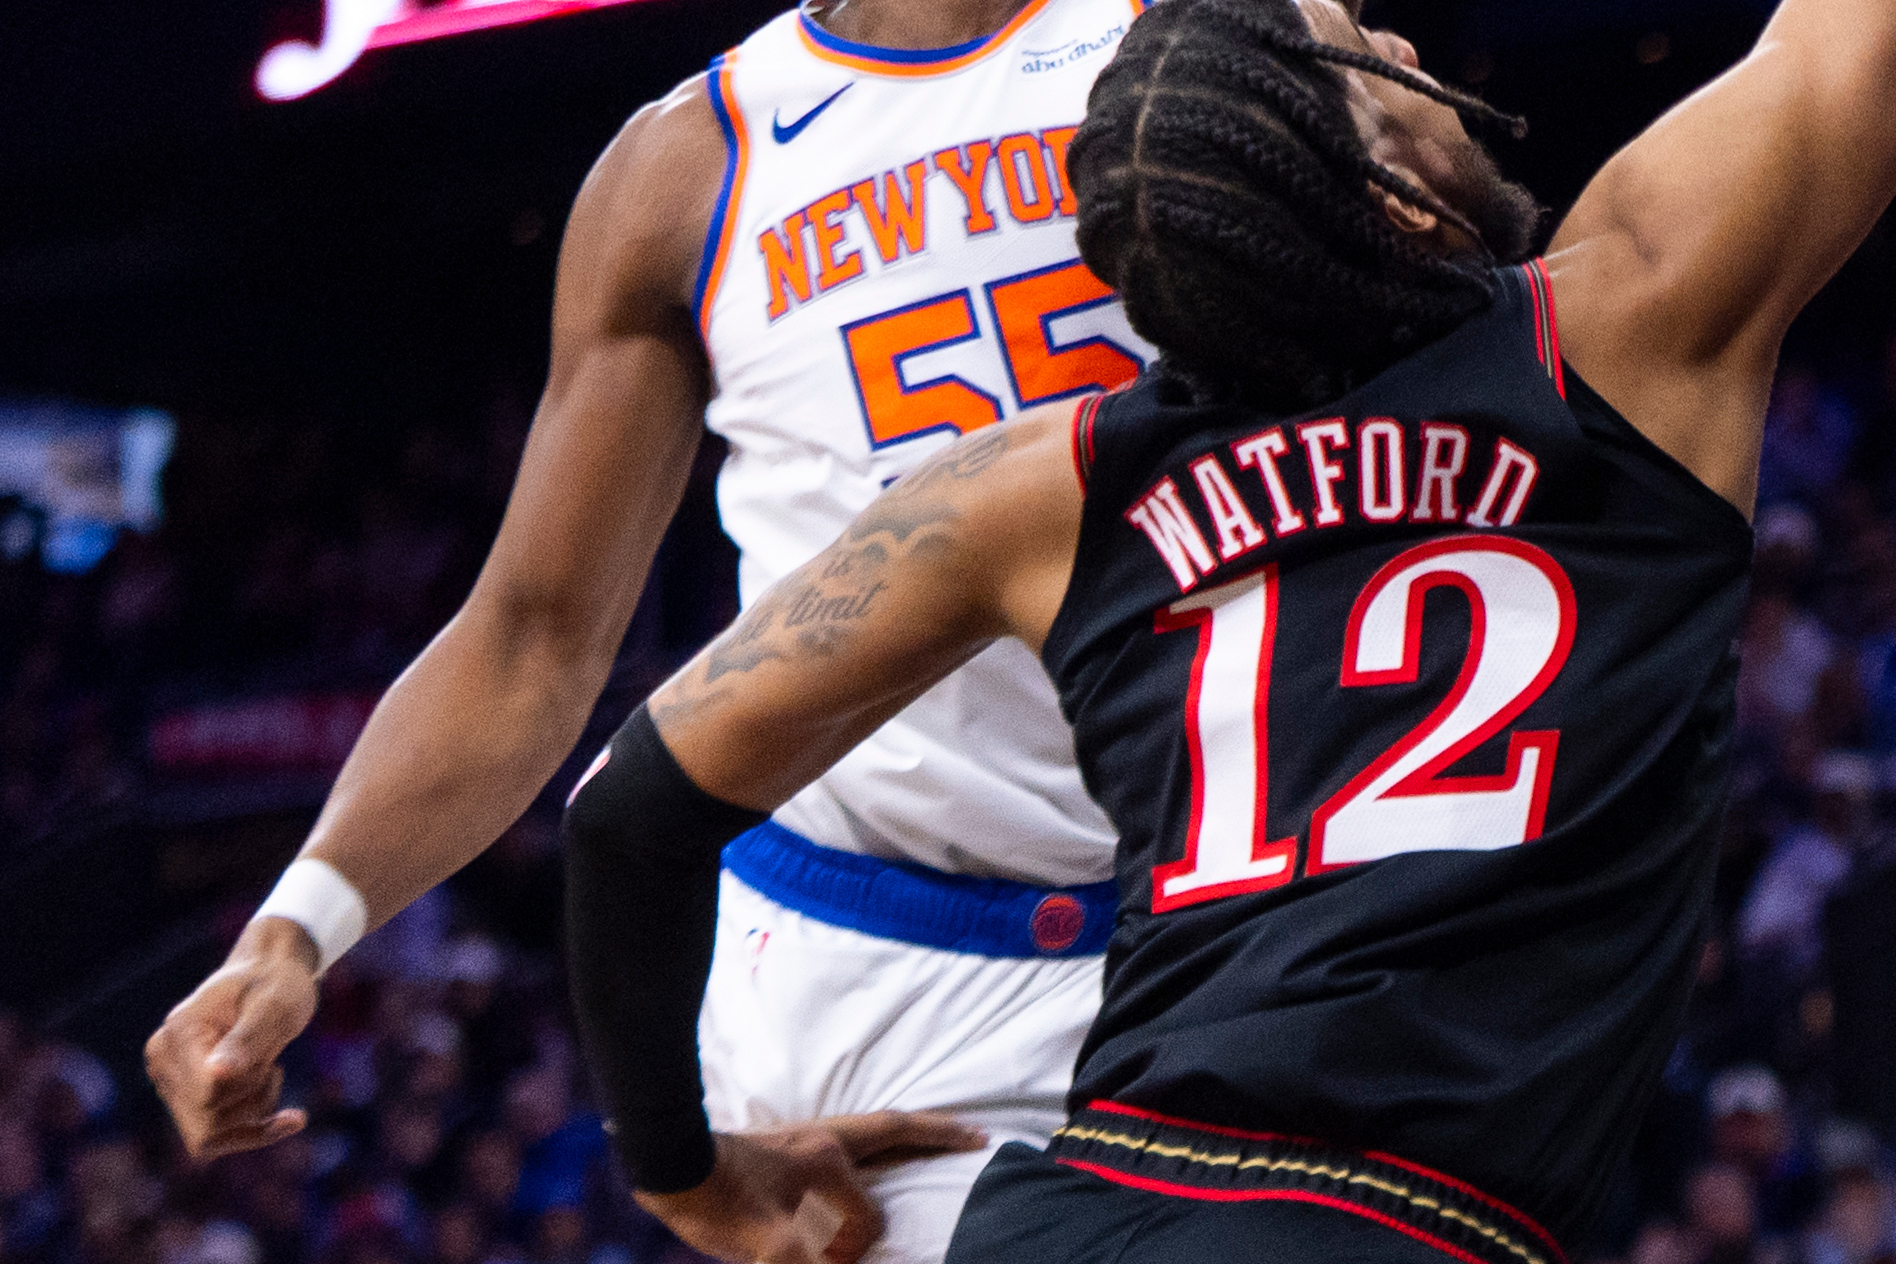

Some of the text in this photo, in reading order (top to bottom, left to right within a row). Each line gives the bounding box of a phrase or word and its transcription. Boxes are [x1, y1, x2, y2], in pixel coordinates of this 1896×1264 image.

[757, 124, 1080, 323] NEW YO
[838, 256, 1147, 453] 55
[1123, 416, 1540, 594] WATFORD
[1151, 534, 1578, 914] 12
